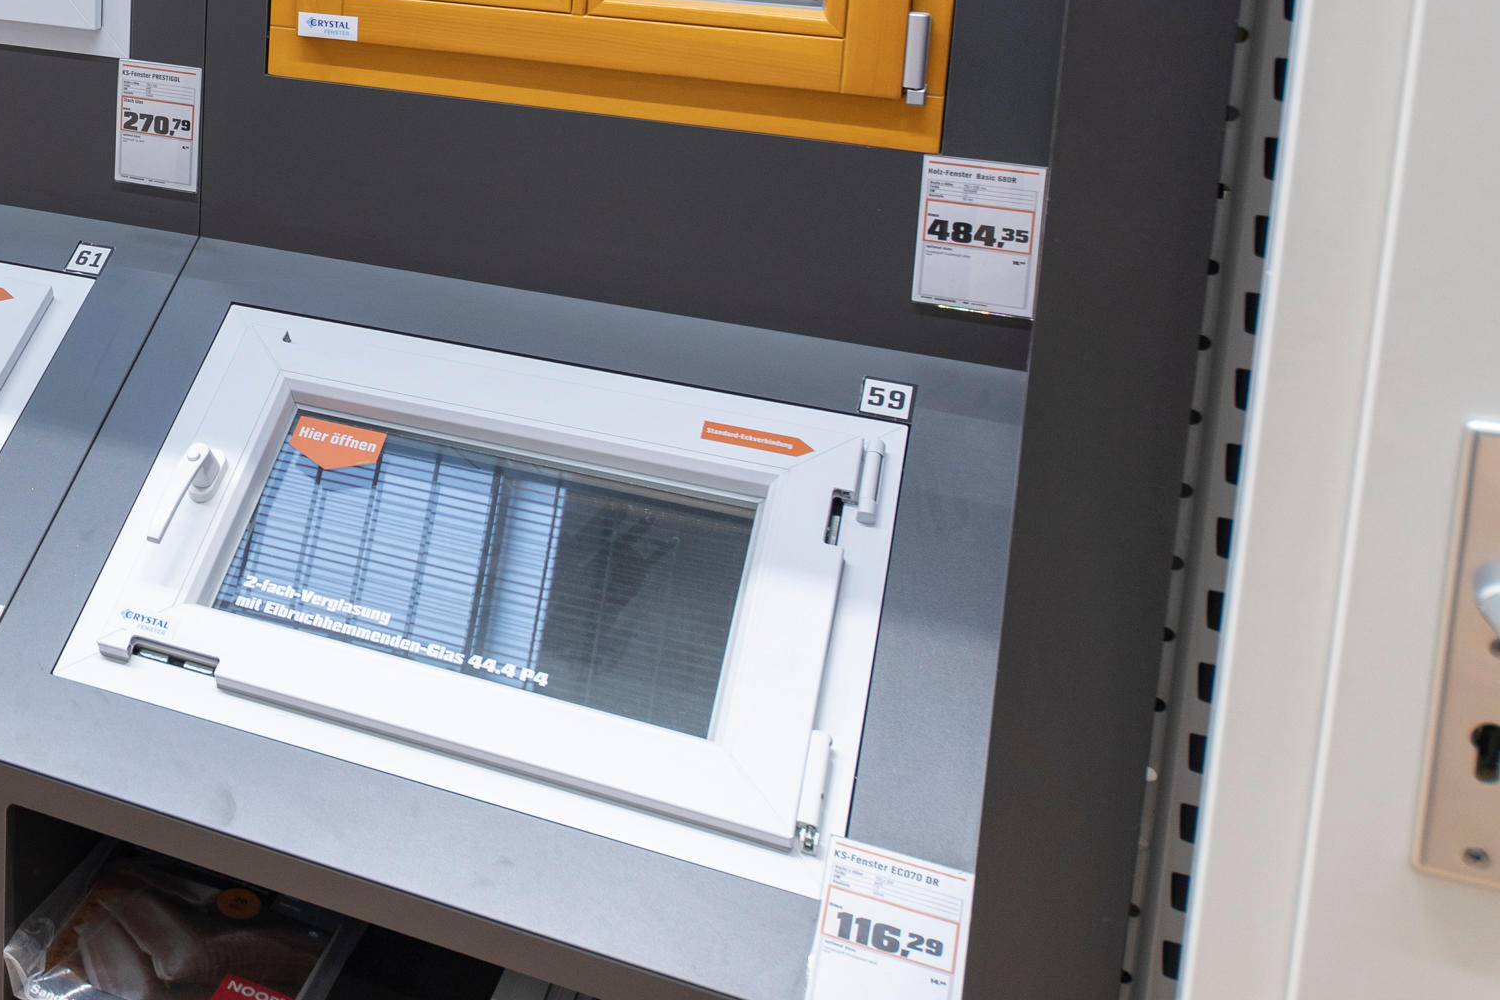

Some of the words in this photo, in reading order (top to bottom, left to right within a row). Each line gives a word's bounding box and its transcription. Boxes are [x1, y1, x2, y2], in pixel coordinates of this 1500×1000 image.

[309, 18, 351, 30] CRYSTAL
[122, 111, 191, 137] 270,79
[928, 168, 973, 179] Holz-Fenster
[927, 218, 1029, 248] 484,35
[74, 250, 103, 269] 61
[867, 386, 907, 410] 59
[298, 426, 330, 442] Hier
[329, 432, 377, 453] öffnen
[705, 426, 794, 450] Standard-Eckverbindung
[242, 575, 392, 626] 2-fach-Verglasung
[124, 610, 169, 629] CRYSTAL
[234, 595, 263, 612] mit
[263, 601, 467, 665] Eibruchhemmenden-Glas
[466, 653, 518, 680] 44.4
[518, 667, 549, 688] P4
[833, 850, 889, 872] KS-Fenster
[836, 911, 944, 958] 116,29
[226, 979, 287, 1000] NOO
